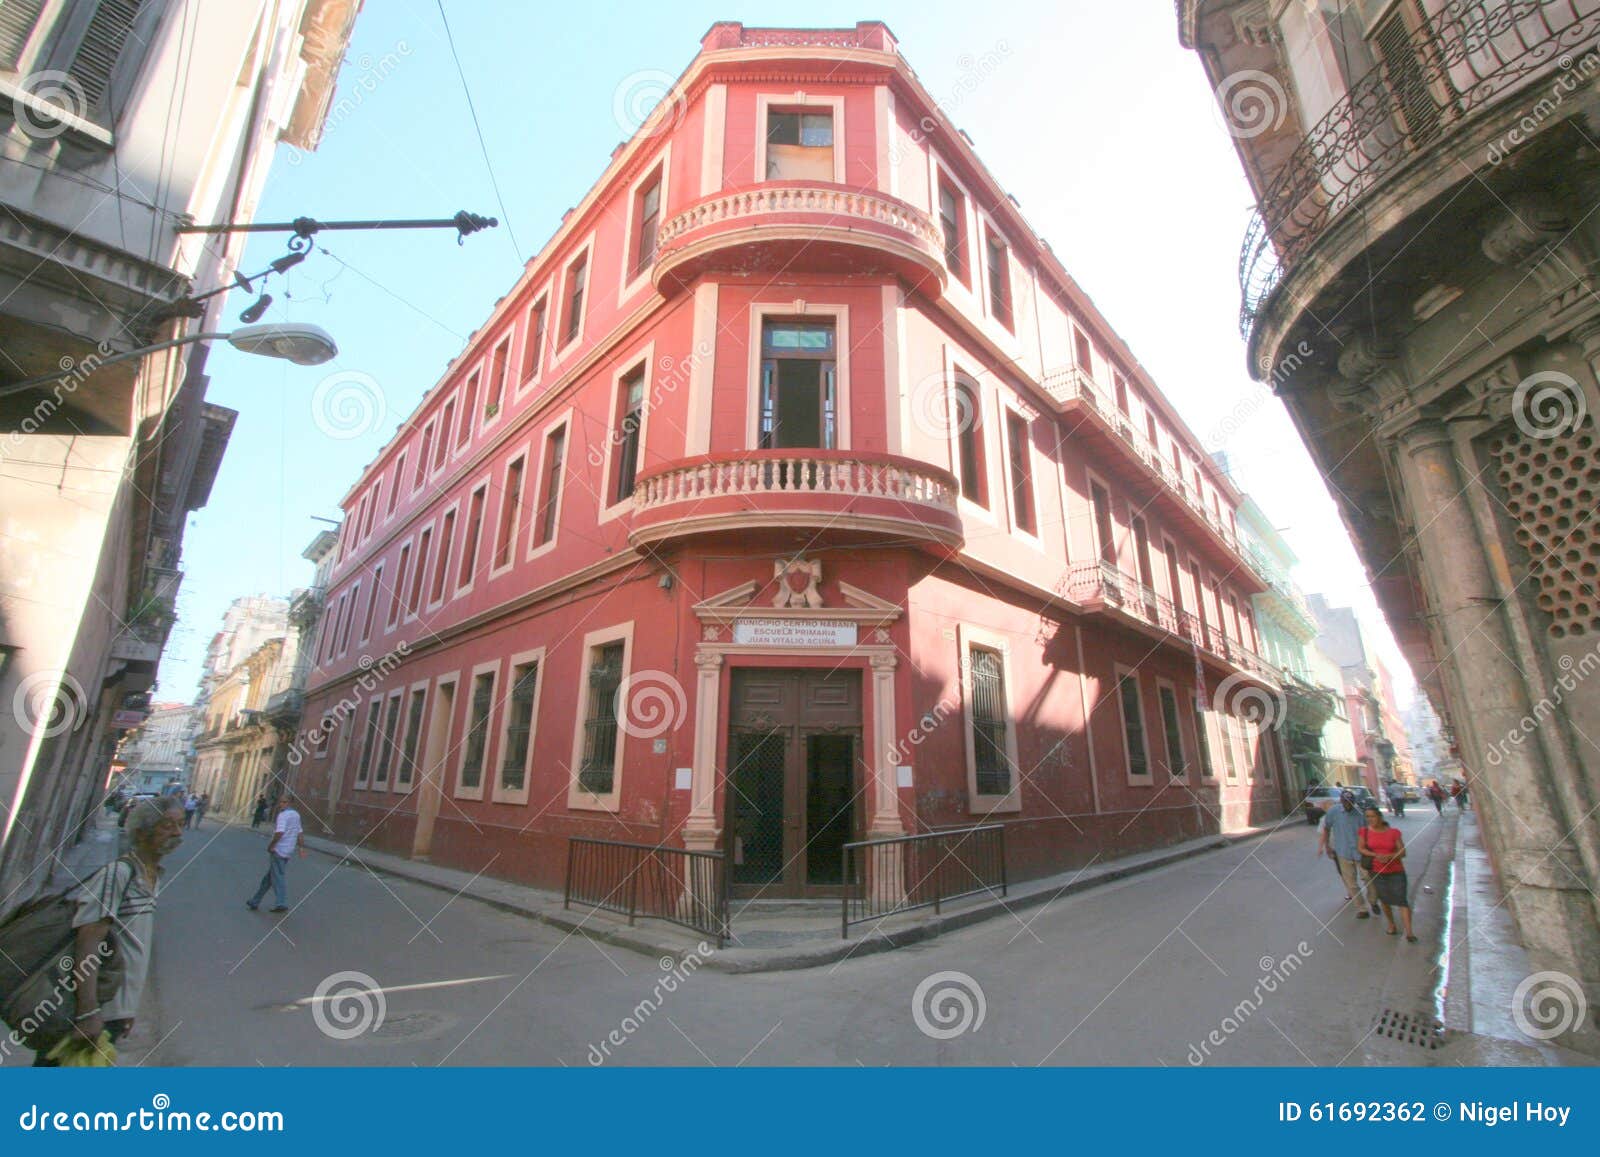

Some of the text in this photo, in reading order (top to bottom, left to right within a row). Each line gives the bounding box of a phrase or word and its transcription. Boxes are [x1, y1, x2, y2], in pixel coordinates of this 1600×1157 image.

[736, 618, 781, 627] MUNICIPIO
[783, 619, 818, 628] CENTRO
[795, 628, 836, 636] PRIMARIA
[750, 636, 770, 644] JUAN
